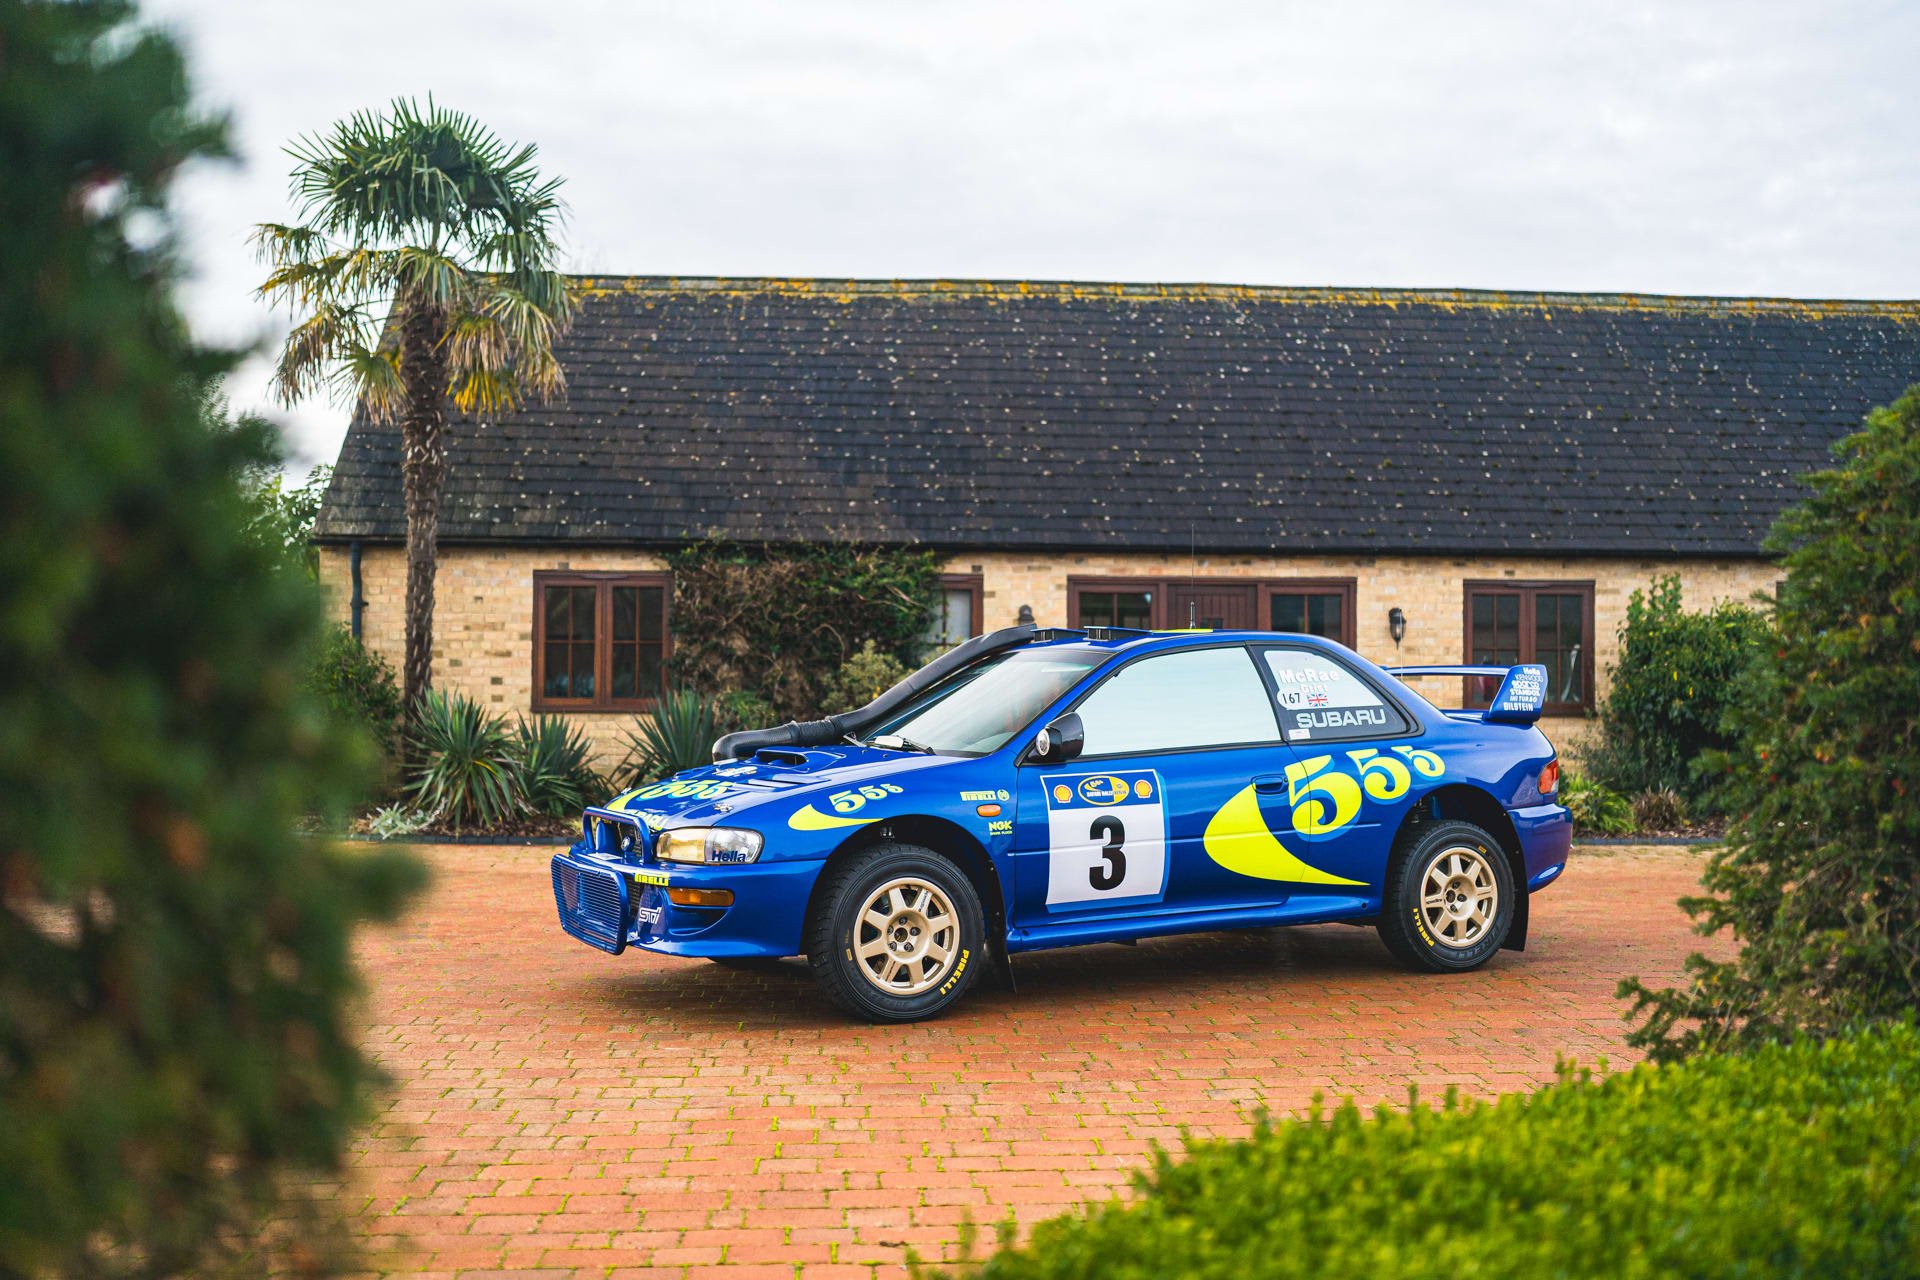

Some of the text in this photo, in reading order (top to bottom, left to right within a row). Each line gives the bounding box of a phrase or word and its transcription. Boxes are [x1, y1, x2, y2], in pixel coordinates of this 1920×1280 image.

[1279, 668, 1339, 684] McRae
[1282, 692, 1301, 704] 167
[1503, 702, 1533, 711] BILSTEIN
[1296, 709, 1386, 728] SUBARU
[829, 783, 904, 814] 555
[1284, 746, 1446, 840] 555
[988, 820, 1012, 831] NGK
[711, 850, 747, 862] Hella
[1089, 815, 1126, 891] 3
[634, 869, 670, 887] PIRELLI
[1413, 908, 1435, 947] PIRELLI
[939, 949, 970, 996] PIRELLI
